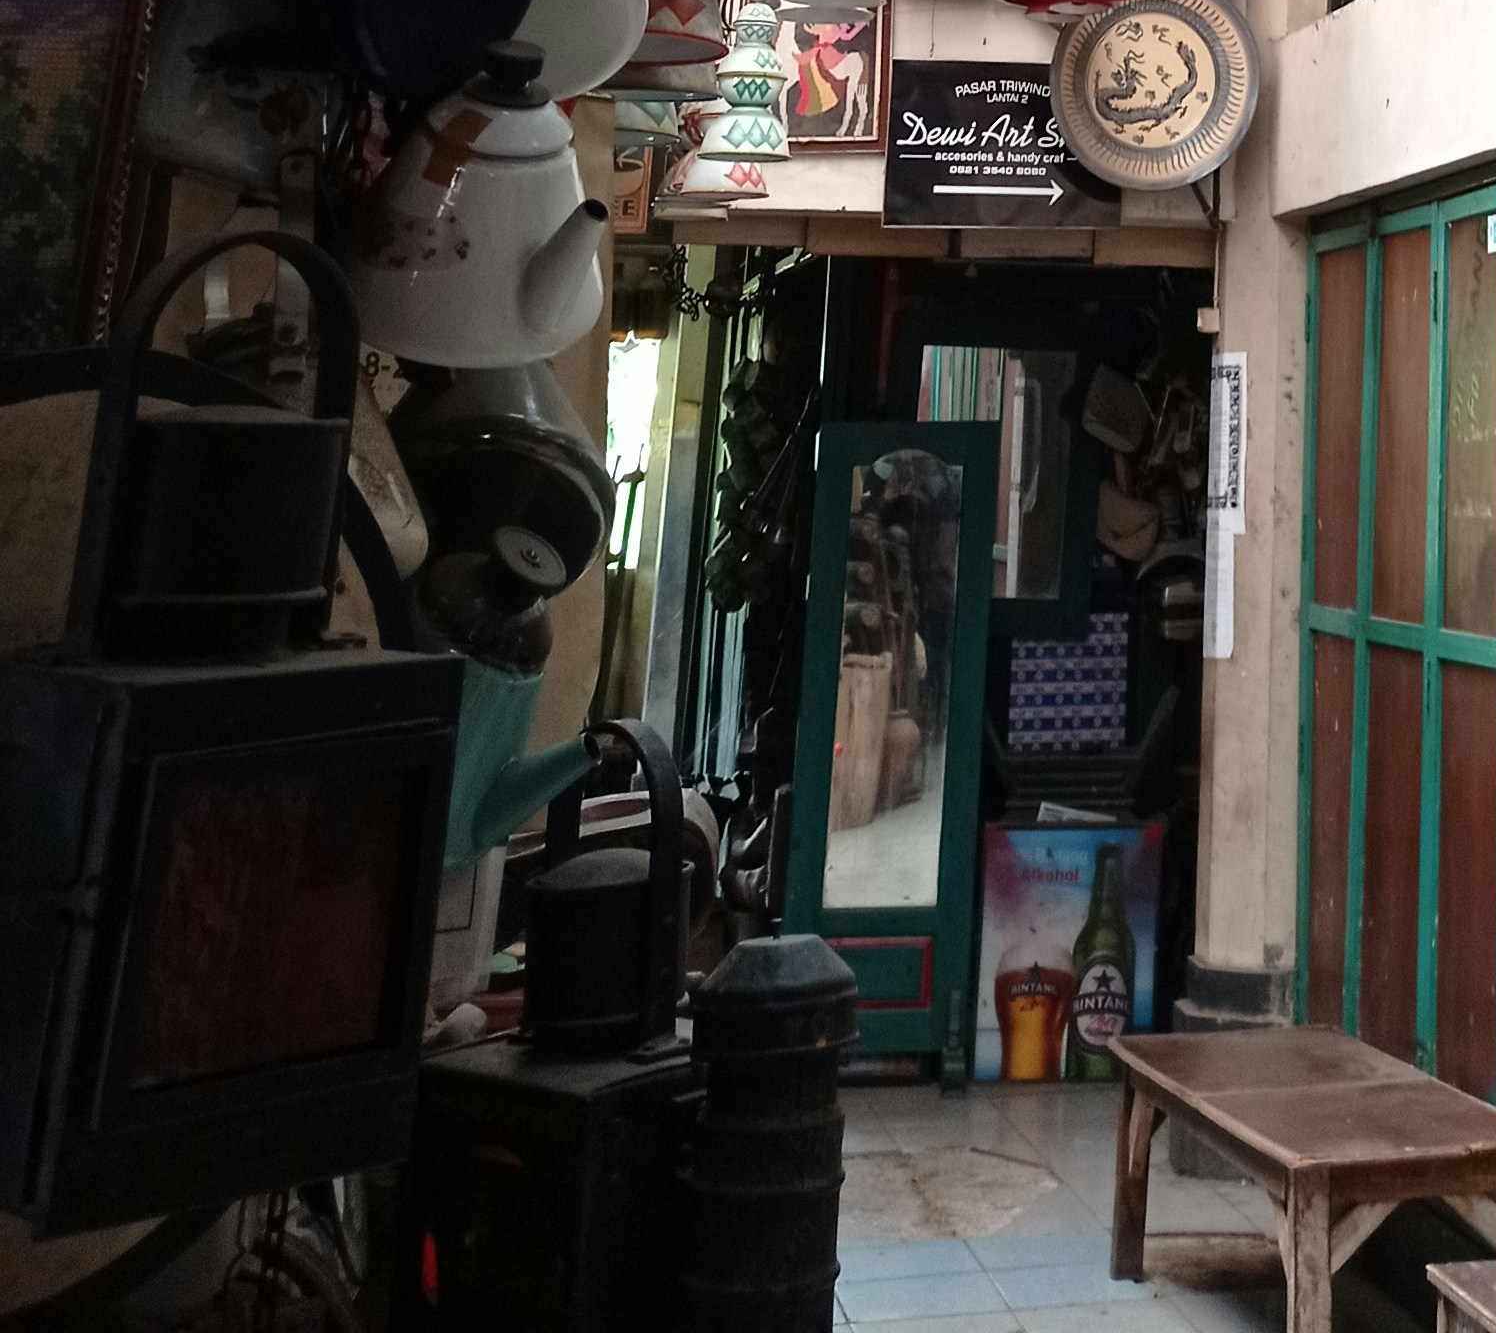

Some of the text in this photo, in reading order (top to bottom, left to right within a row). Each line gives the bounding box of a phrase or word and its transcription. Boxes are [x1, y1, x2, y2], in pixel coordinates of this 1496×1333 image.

[955, 80, 1050, 98] PASAR TRIWIND
[1021, 94, 1029, 104] 2
[896, 111, 1066, 148] Dewi Art S
[996, 151, 1005, 163] &
[1007, 151, 1042, 165] handy
